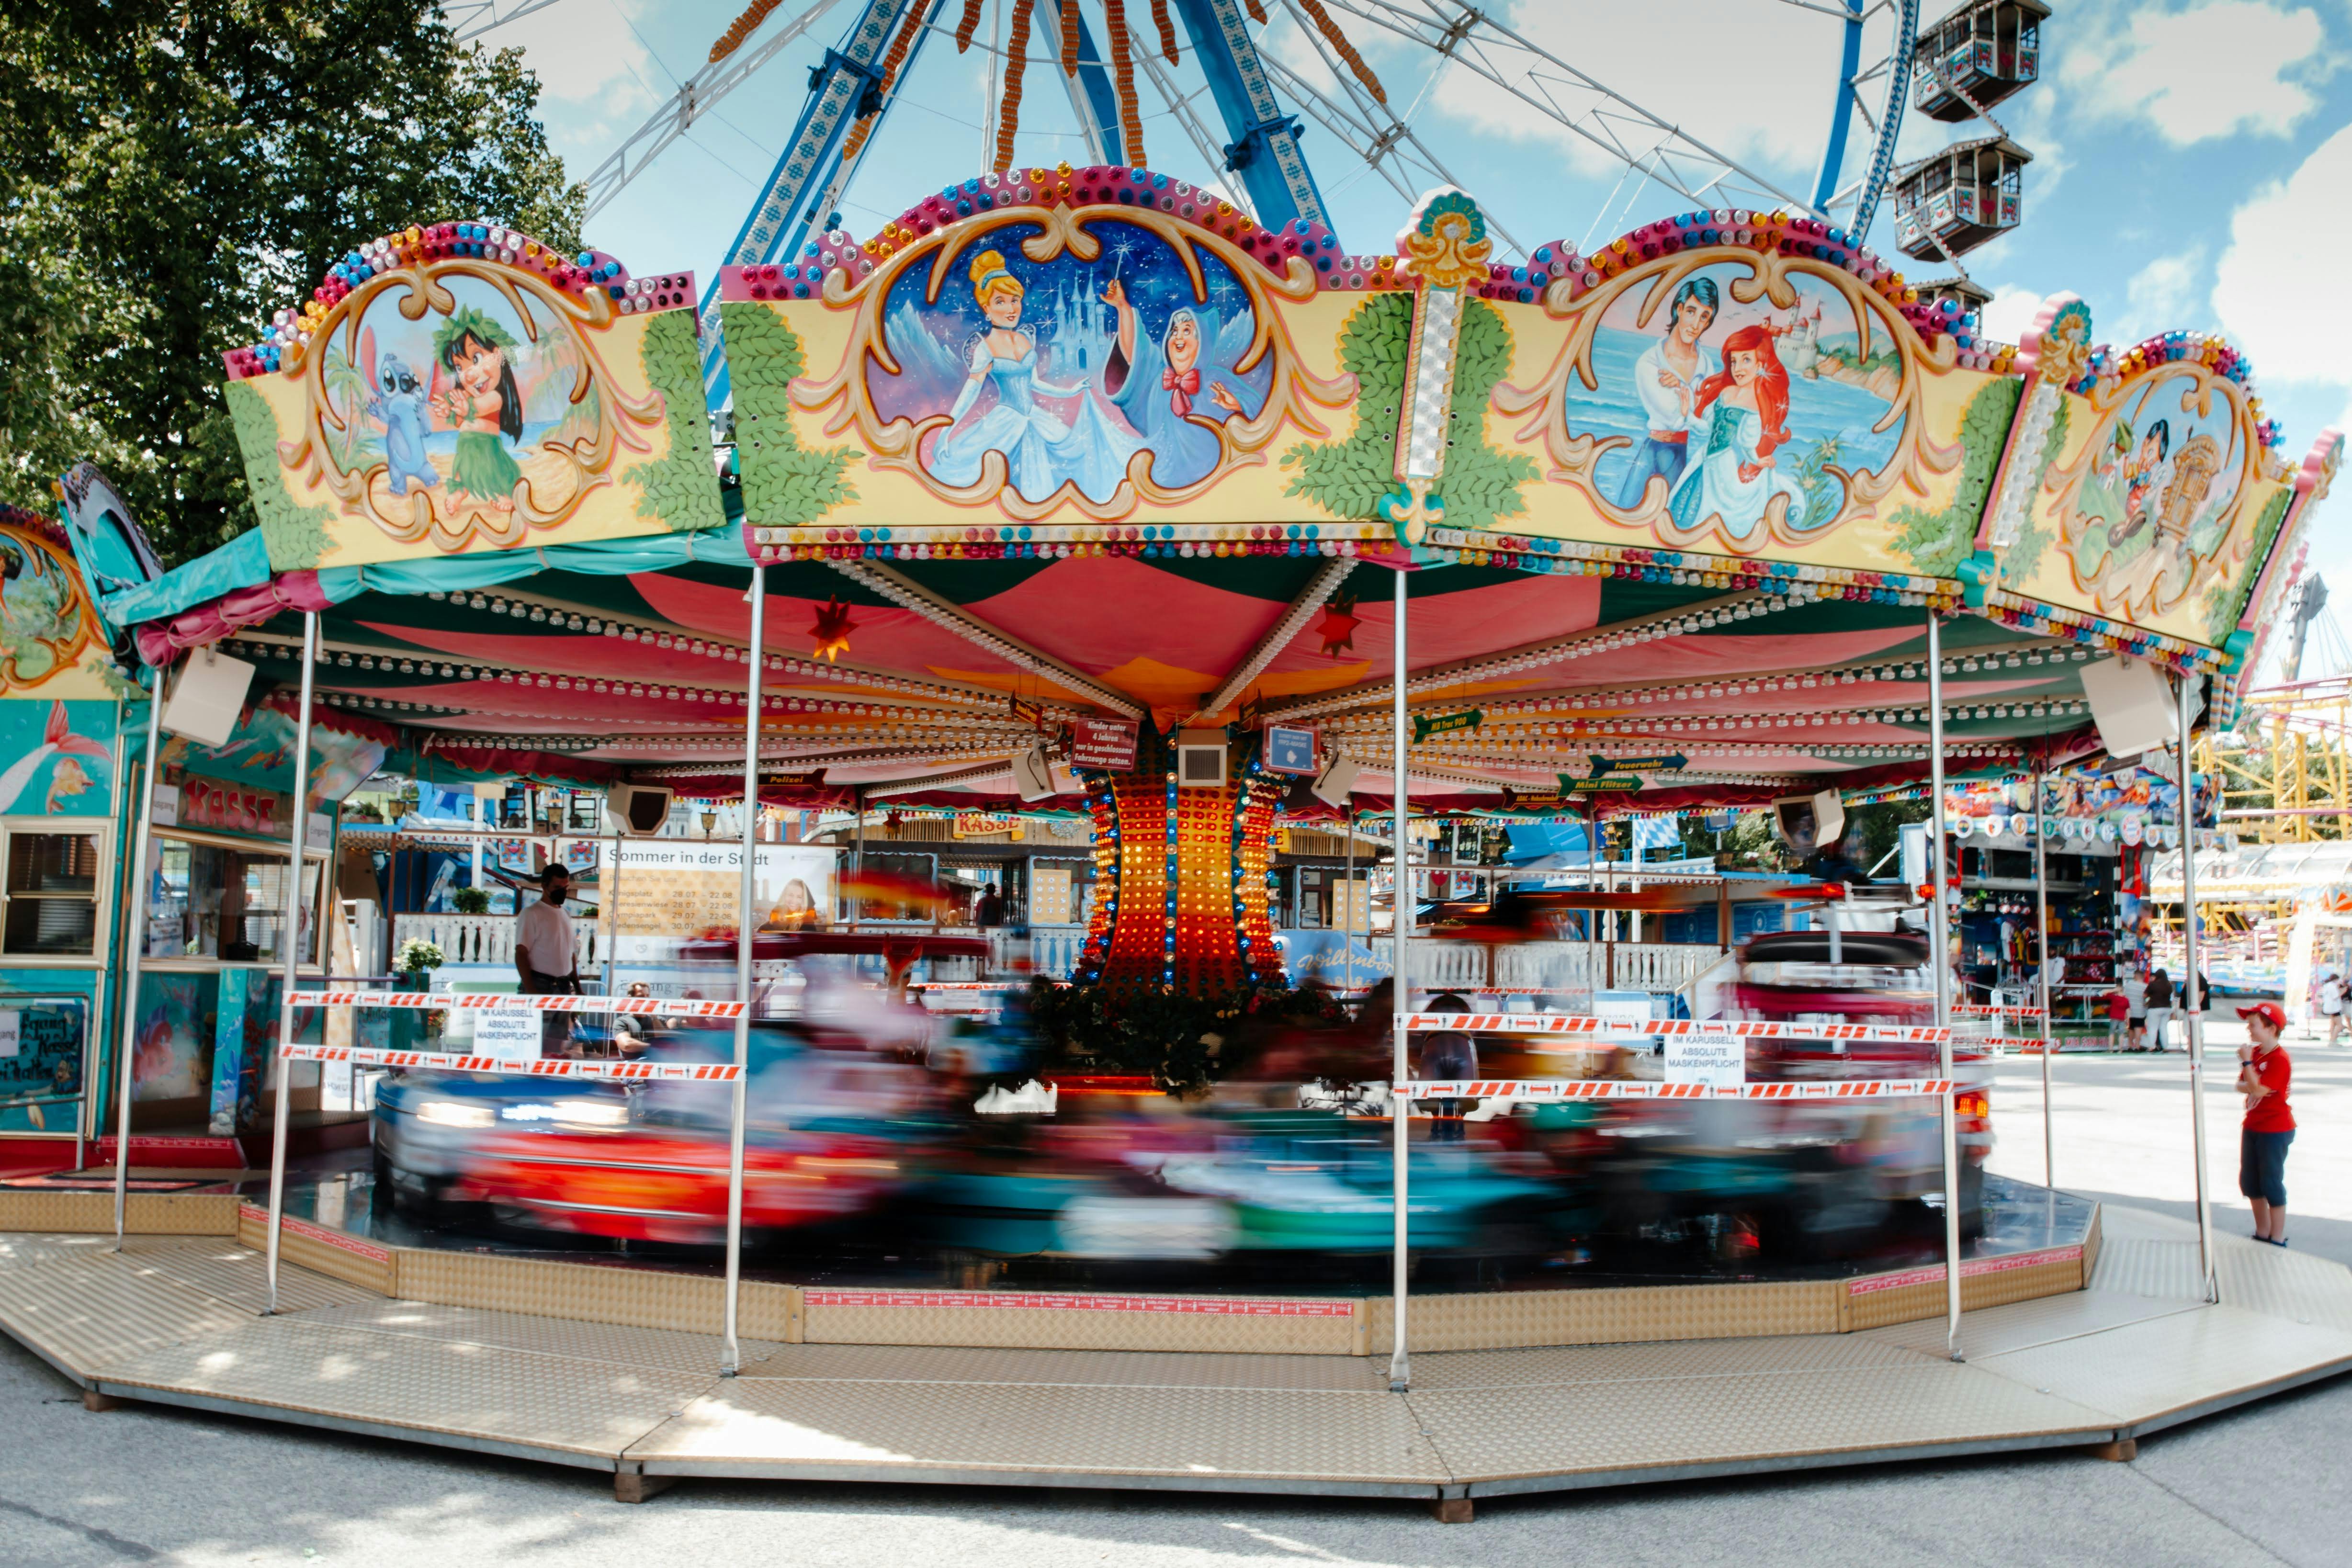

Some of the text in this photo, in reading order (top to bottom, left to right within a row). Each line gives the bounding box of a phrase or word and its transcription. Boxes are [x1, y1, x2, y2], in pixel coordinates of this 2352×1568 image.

[1088, 721, 1108, 730] Kinder
[1098, 733, 1119, 742] Jahren
[1094, 745, 1132, 755] geschlossene
[1074, 753, 1131, 765] Fahrzeuge setzen.
[1615, 759, 1663, 770] Feuerwehr
[1575, 780, 1632, 789] Mini Flitzer
[184, 779, 275, 834] KASSE
[959, 817, 1018, 832] KASSE
[609, 849, 769, 866] Sommer in der Stdt
[608, 922, 661, 930] Fedensengel
[1297, 948, 1394, 973] Willenbor
[491, 1009, 533, 1017] KARUSSELL
[487, 1020, 526, 1028] ABSOLUTE
[476, 1031, 537, 1040] MASKENPFLICHT
[1673, 1036, 1736, 1044] IM KARUSSELL
[1682, 1048, 1728, 1056] ABSOLUTE
[1668, 1059, 1741, 1068] MASKENPFLICHT
